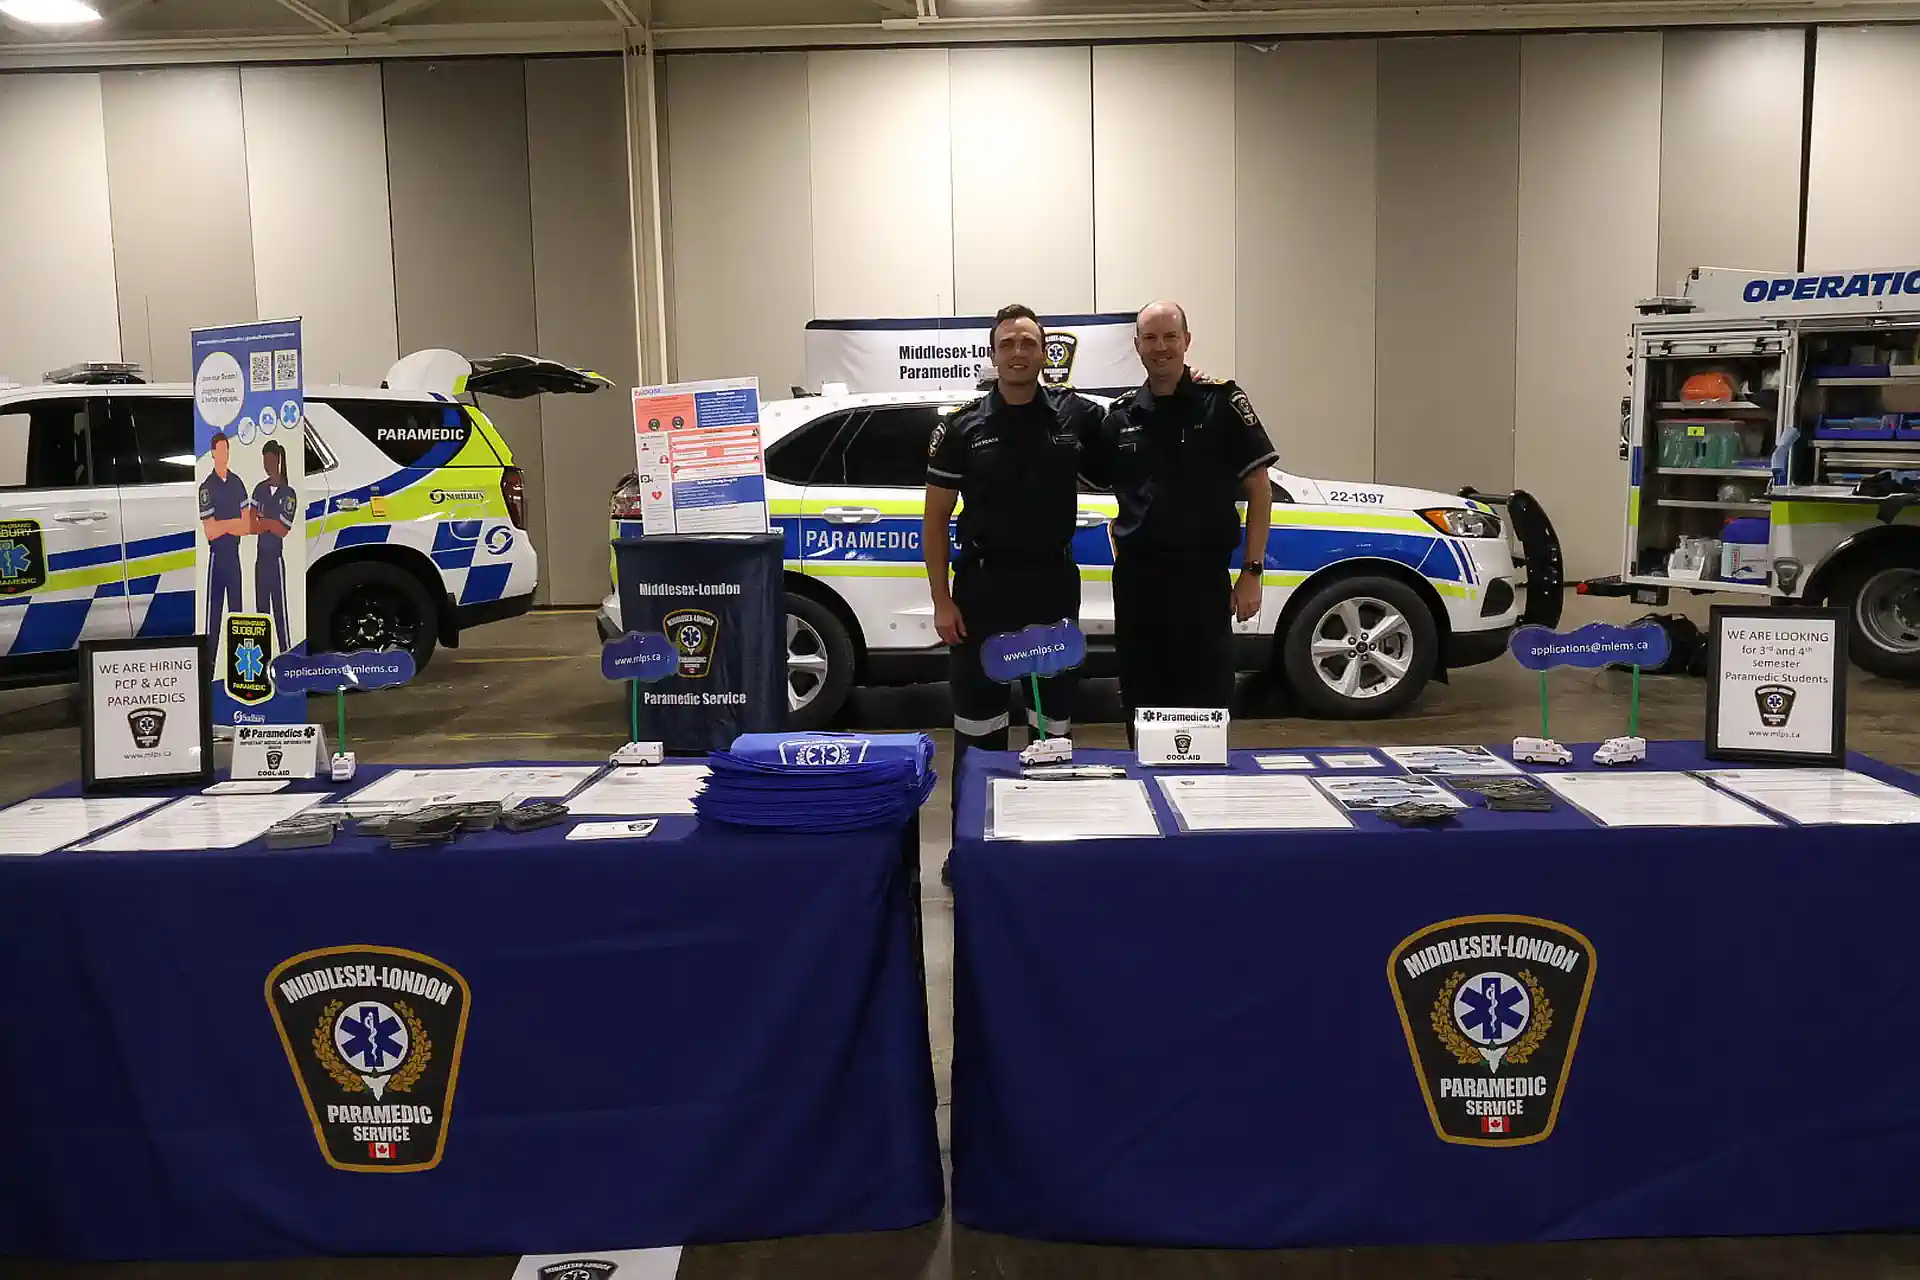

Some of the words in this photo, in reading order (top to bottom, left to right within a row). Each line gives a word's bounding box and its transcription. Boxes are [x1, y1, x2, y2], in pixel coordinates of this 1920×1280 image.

[899, 344, 992, 360] Middlesex-Lon
[900, 364, 971, 380] Paramedic
[377, 428, 465, 441] PARAMEDIC
[1330, 490, 1384, 504] 22-1397
[0, 528, 32, 538] BURY
[805, 530, 920, 550] PARAMEDIC
[639, 582, 741, 596] Middlesex-London
[231, 625, 266, 637] SUDBURY
[1727, 629, 1746, 640] WE
[1749, 631, 1771, 641] ARE
[1775, 632, 1829, 642] LOOKING
[1003, 642, 1066, 662] www.mlps.ca
[1530, 640, 1649, 656] applications@mlems.ca
[1742, 645, 1757, 655] for
[1776, 646, 1796, 656] and
[614, 652, 661, 666] www.mlps.ca
[1752, 660, 1801, 668] semester
[99, 663, 119, 674] WE
[122, 662, 146, 673] ARE
[150, 660, 192, 672] HIRING
[115, 679, 137, 690] PCP
[141, 679, 151, 688] &
[154, 677, 178, 688] ACP
[1725, 671, 1779, 682] Paramedic
[1782, 673, 1829, 684] Students
[107, 693, 186, 707] PARAMEDICS
[644, 692, 700, 705] Paramedic
[702, 692, 747, 705] Service
[1156, 711, 1210, 722] Paramedics
[251, 728, 303, 738] Paramedics
[1403, 934, 1580, 979] MIDDLESEX-LONDON
[279, 965, 454, 1005] MIDDLESEX-LONDON
[1440, 1075, 1547, 1098] PARAMEDIC
[327, 1104, 433, 1125] PARAMEDIC
[1465, 1100, 1524, 1116] SERVICE
[352, 1126, 411, 1142] SERVICE
